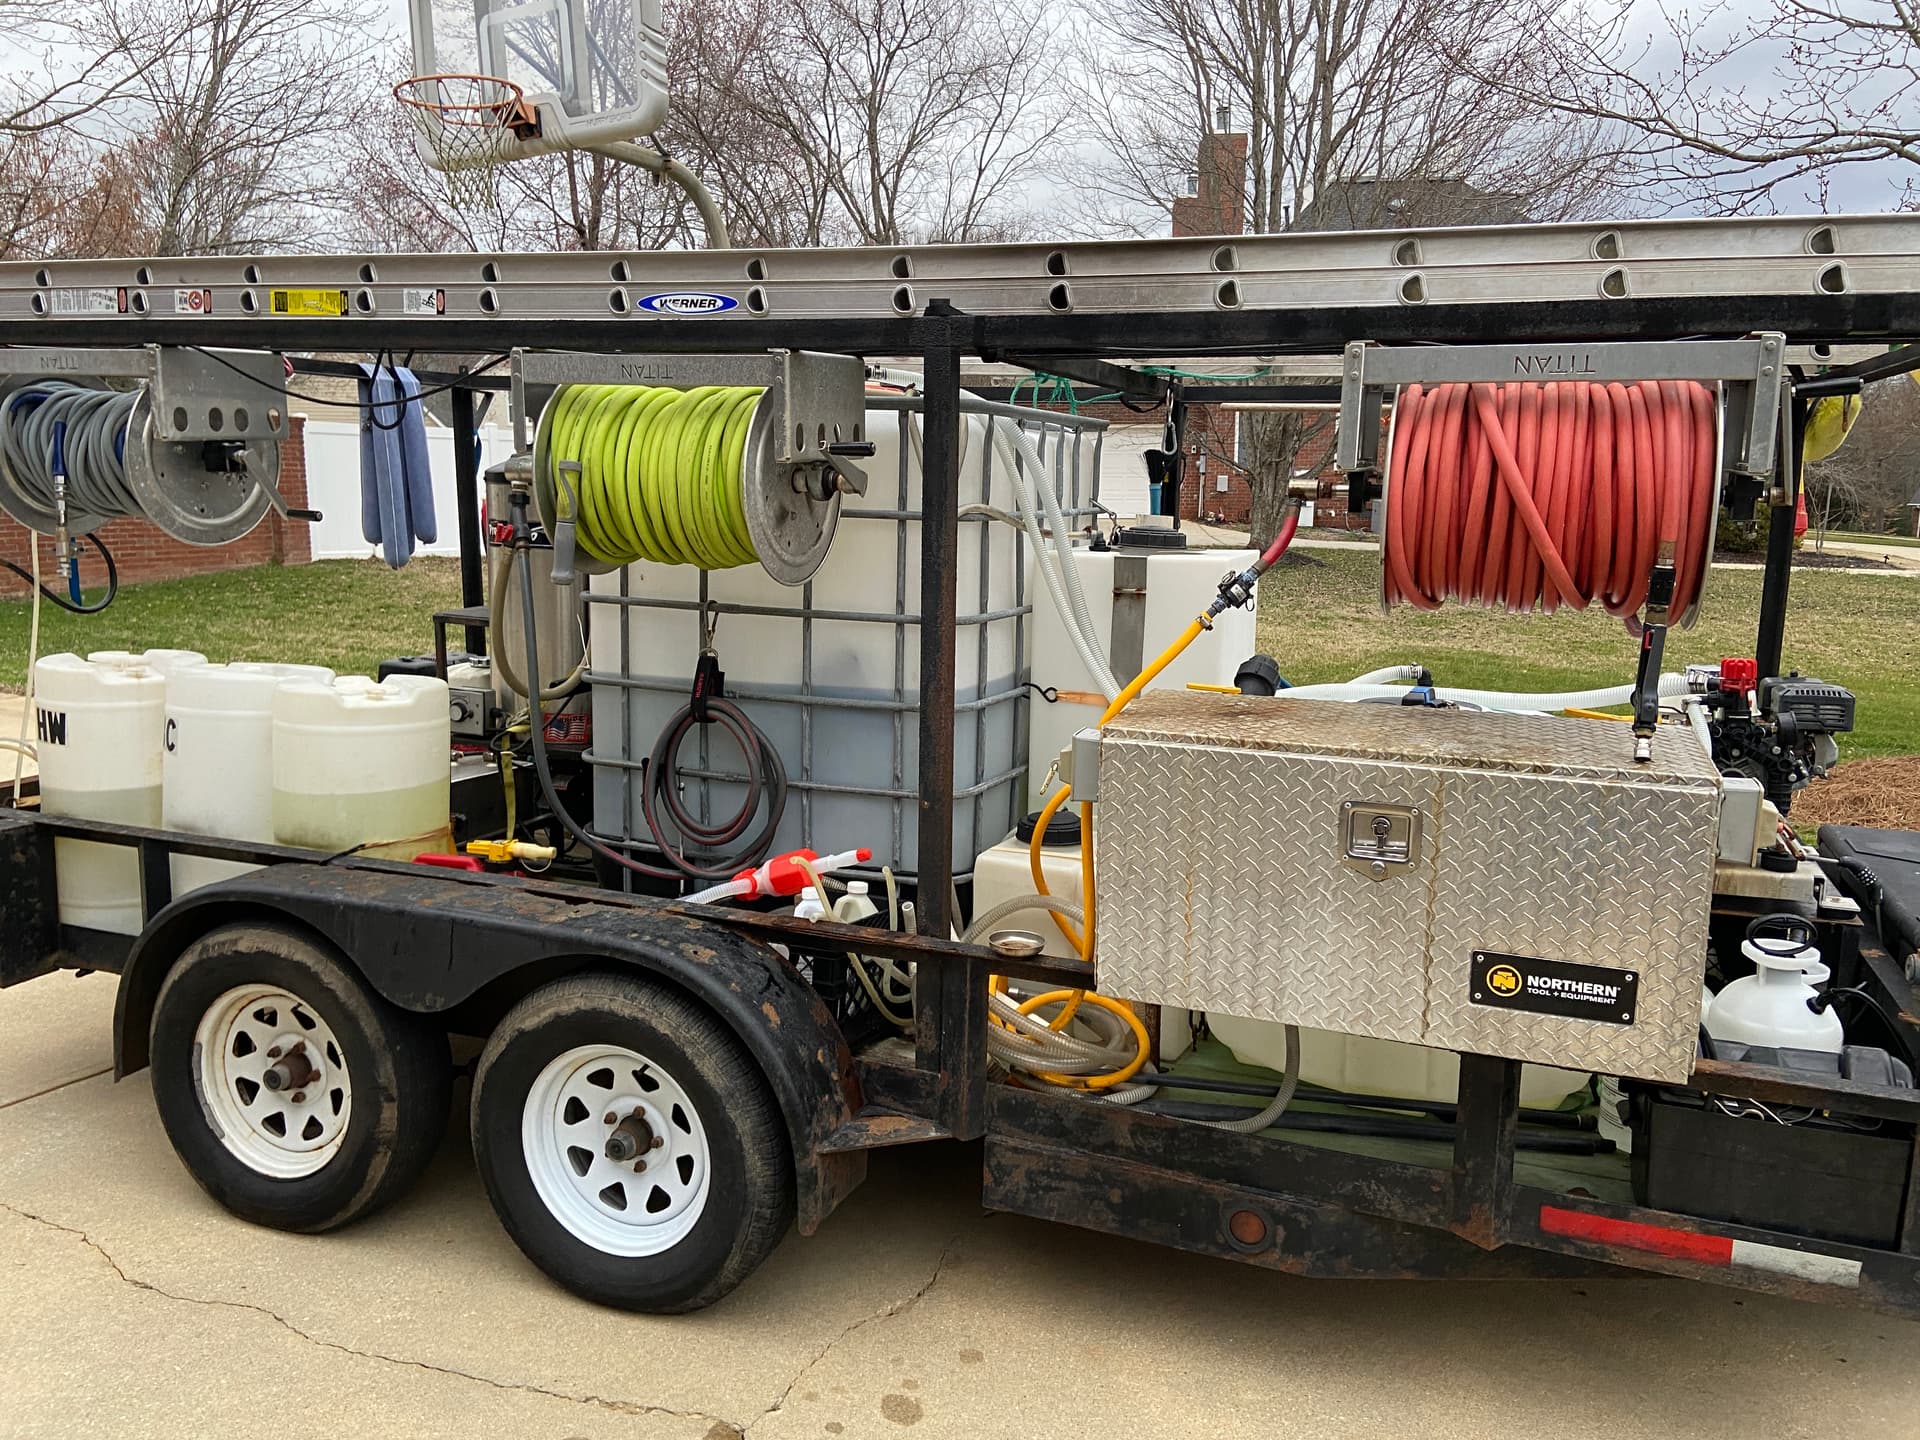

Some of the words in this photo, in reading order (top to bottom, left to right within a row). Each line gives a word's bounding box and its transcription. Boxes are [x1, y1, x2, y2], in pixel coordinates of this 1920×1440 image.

[660, 298, 718, 309] WERNER
[40, 356, 79, 370] TITAN
[621, 364, 674, 379] TITAN
[1514, 355, 1596, 375] TITAN
[37, 706, 67, 745] HW
[1527, 975, 1617, 998] NORTHERN
[1527, 987, 1551, 997] TOOL
[1561, 991, 1617, 1004] EQUIPMENT
